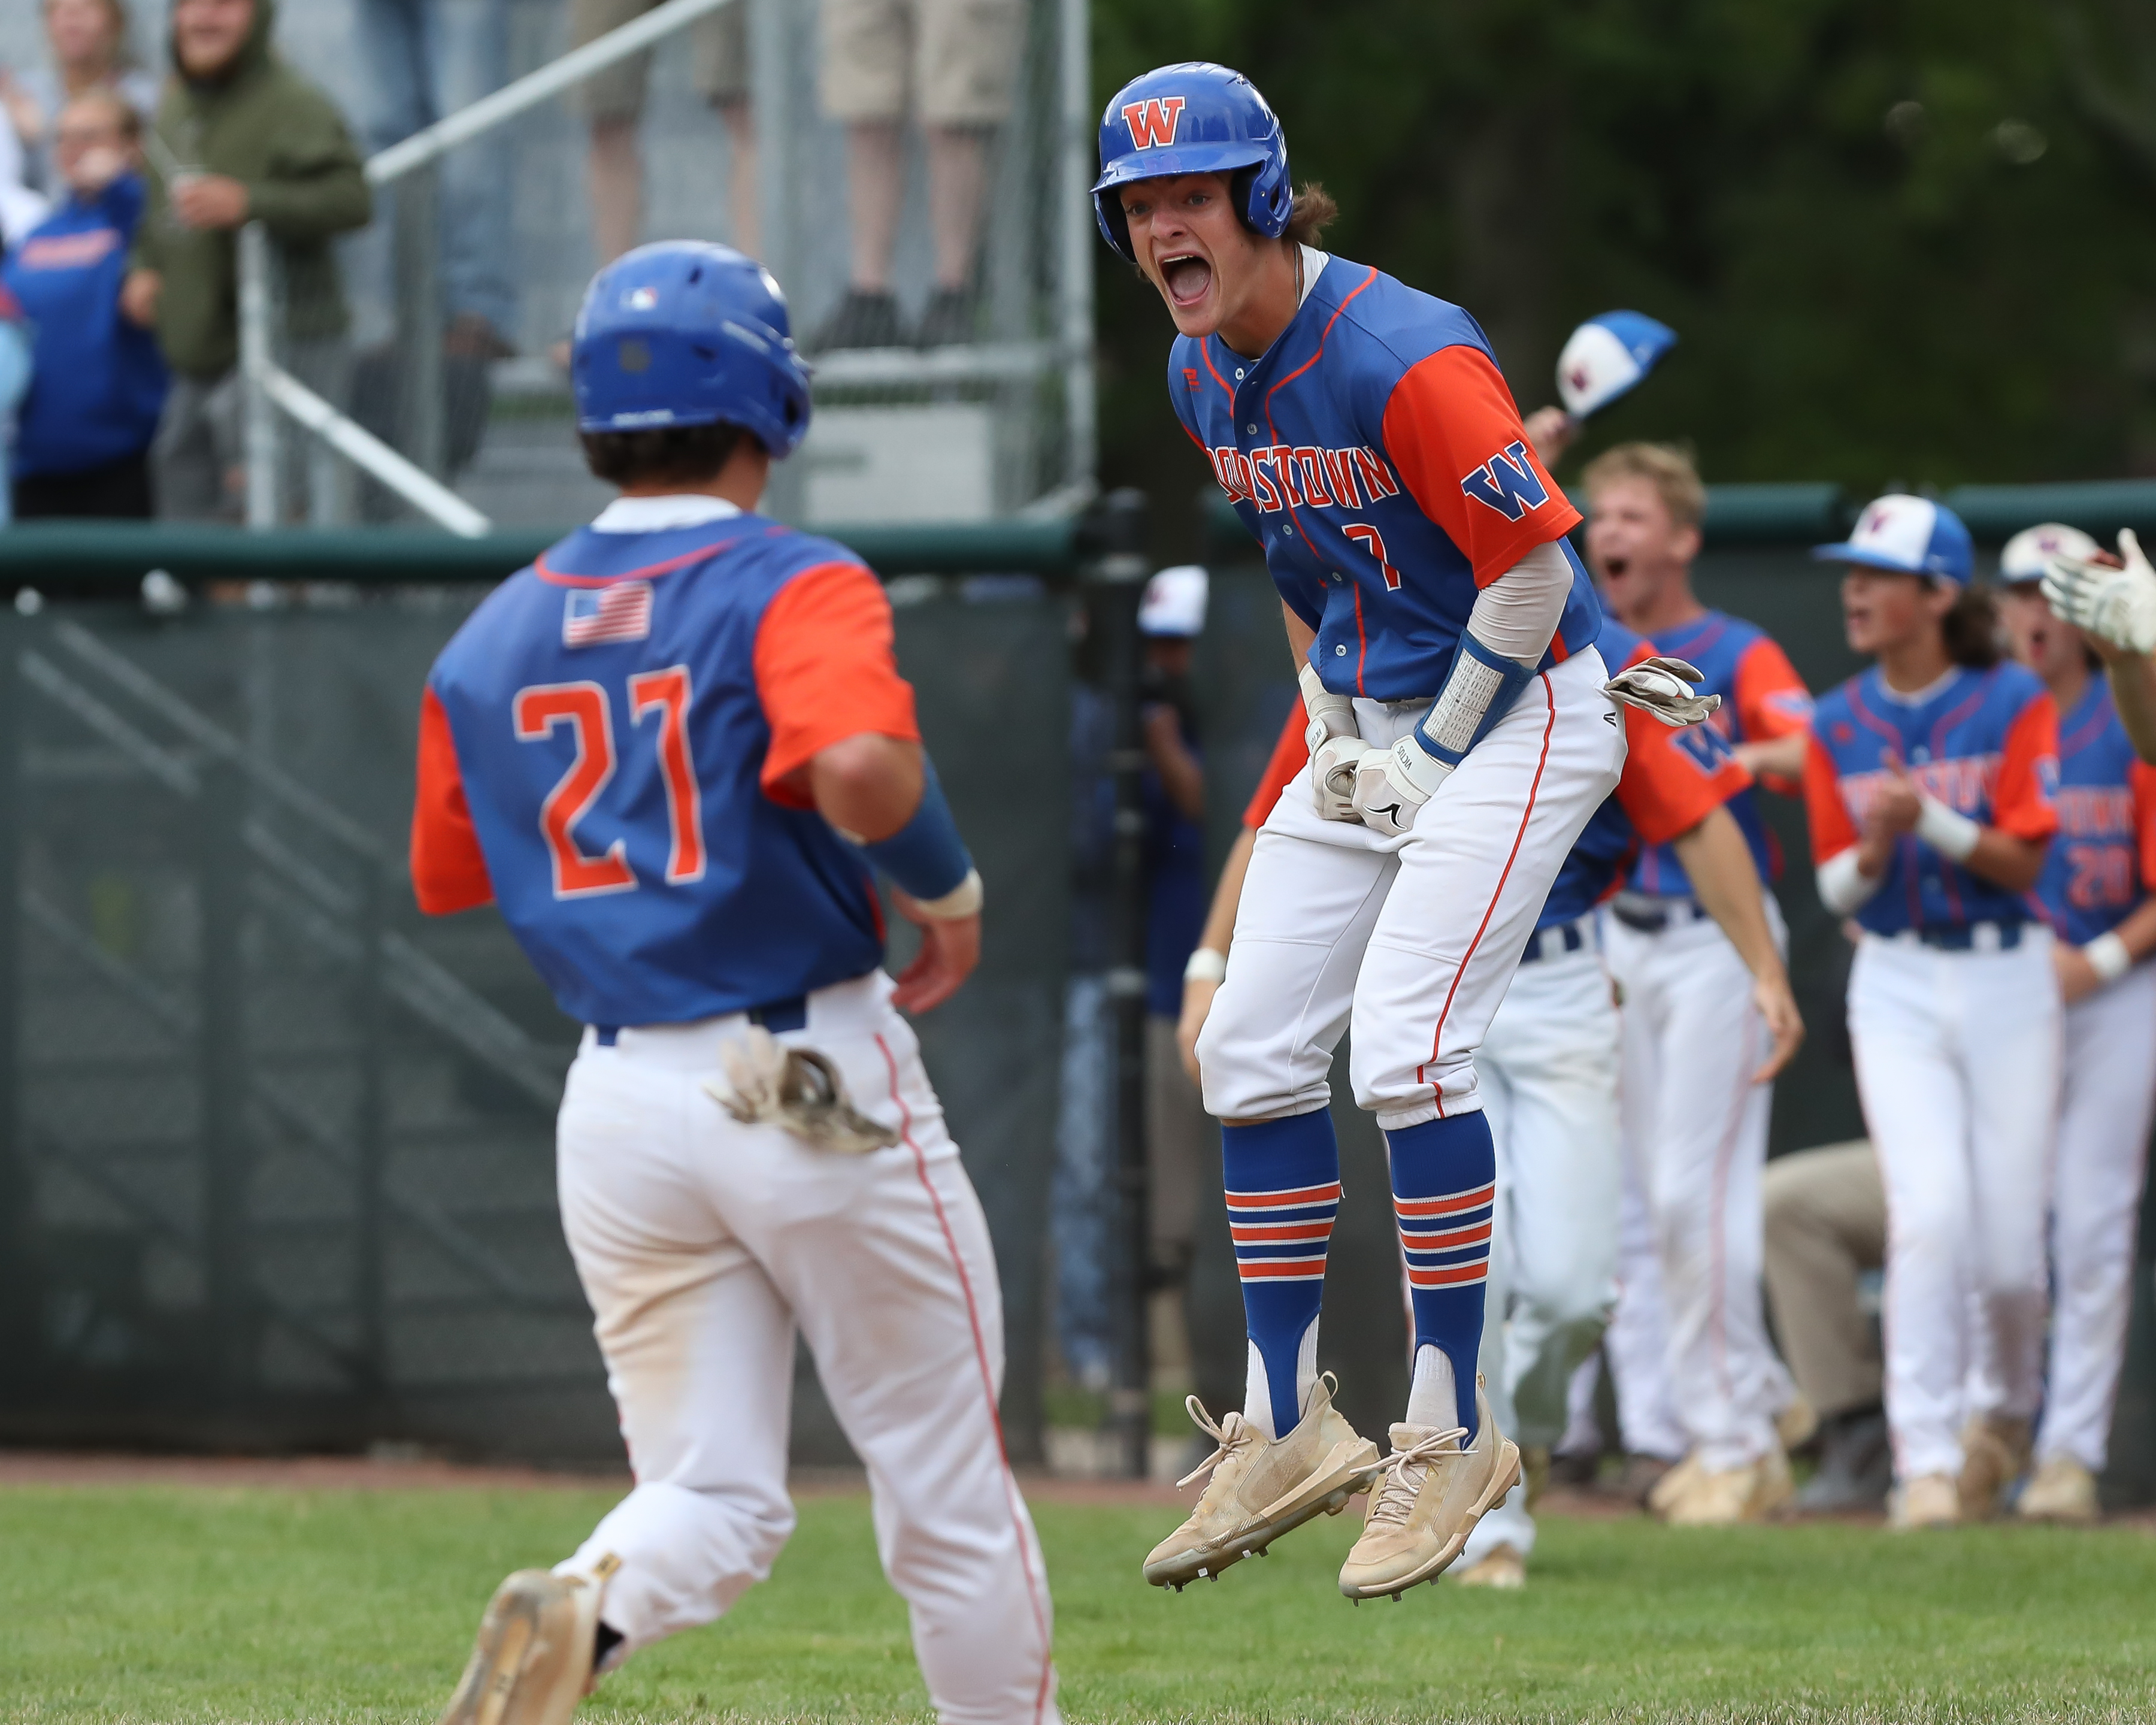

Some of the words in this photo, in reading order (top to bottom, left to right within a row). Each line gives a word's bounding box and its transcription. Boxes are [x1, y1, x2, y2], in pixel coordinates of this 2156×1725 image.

[1121, 95, 1186, 152] W
[1460, 440, 1549, 522] W
[1342, 523, 1401, 592] 7
[512, 663, 707, 901] 27
[1397, 745, 1412, 770] VICTUS
